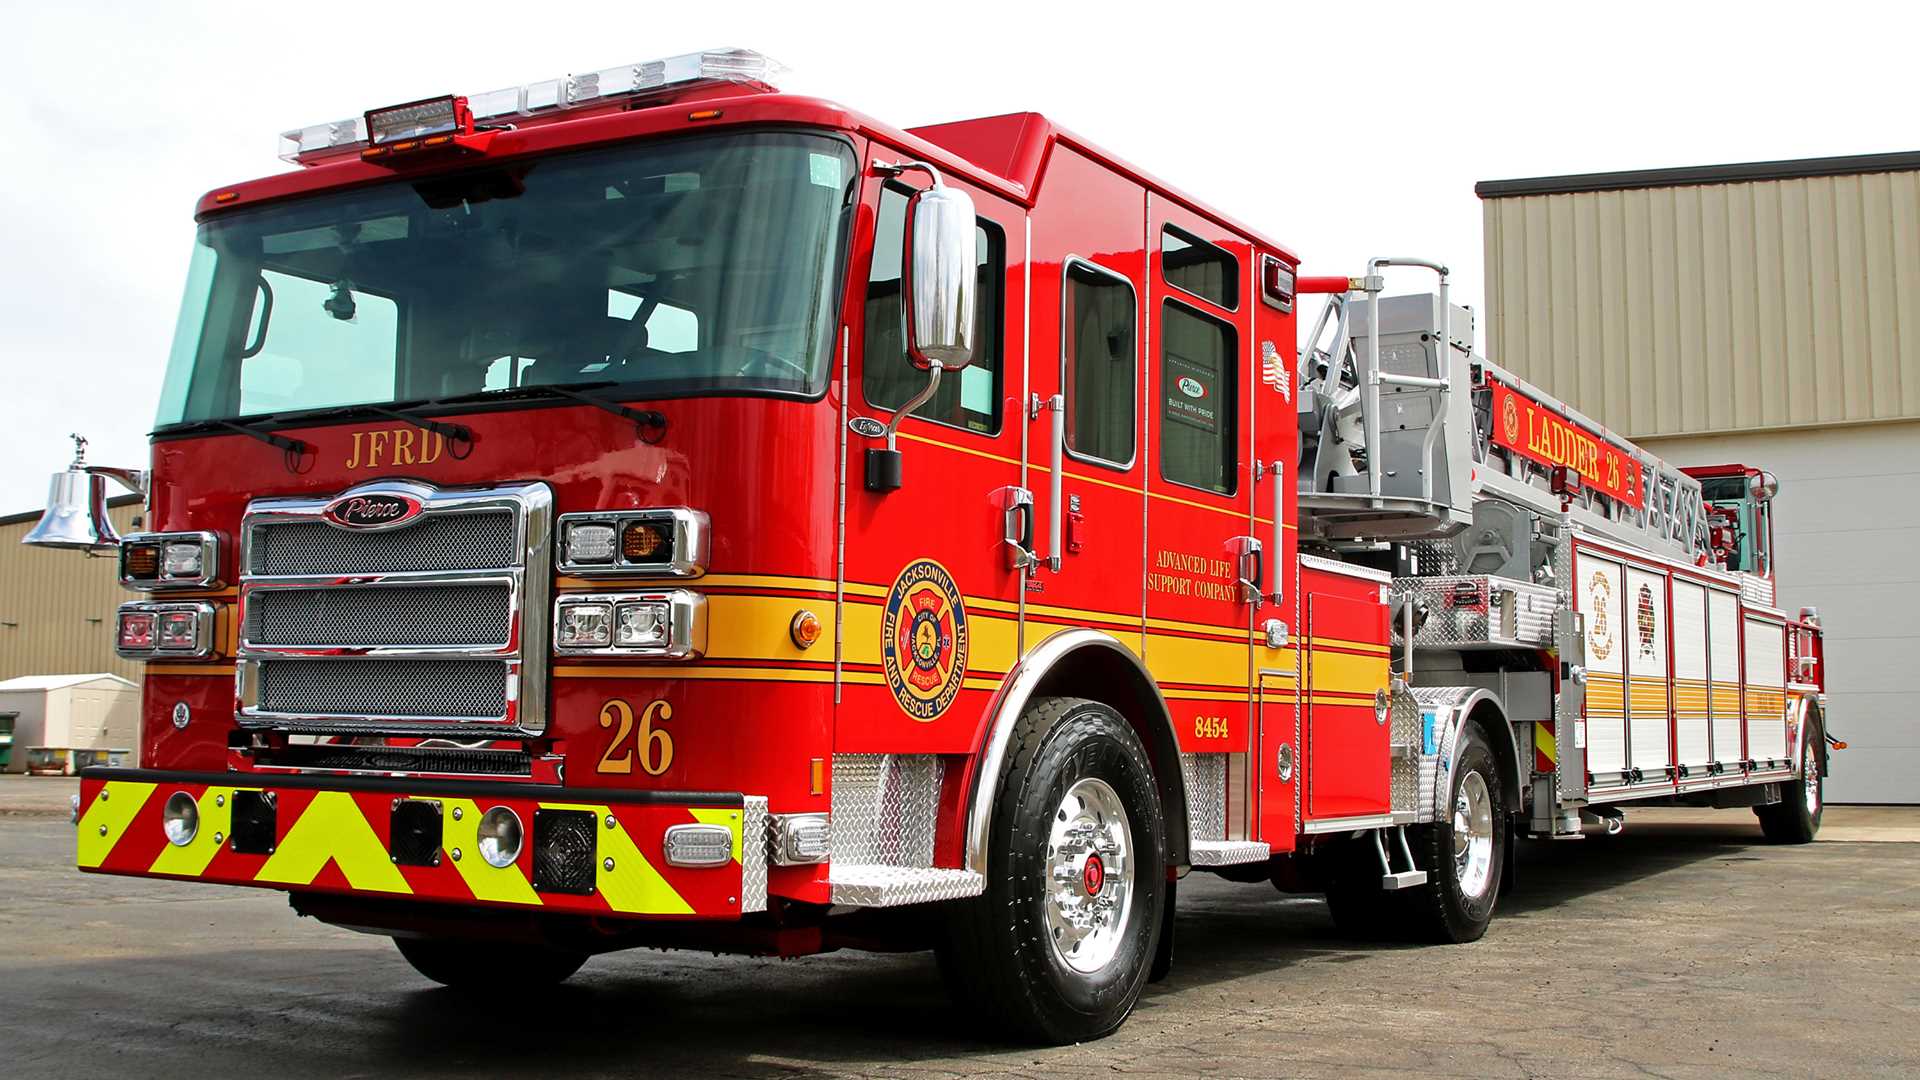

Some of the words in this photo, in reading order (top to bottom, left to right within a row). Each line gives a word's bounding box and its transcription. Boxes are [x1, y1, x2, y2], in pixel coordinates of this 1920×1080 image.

[1168, 398, 1184, 409] BUILT
[1184, 403, 1197, 413] WITH
[1198, 407, 1214, 419] PRIDE
[345, 429, 442, 469] JFRD
[1526, 407, 1600, 482] LADDER
[1606, 451, 1620, 491] 26
[344, 498, 400, 522] Pierce
[1156, 550, 1207, 575] ADVANCED
[1210, 559, 1231, 579] LIFE
[897, 565, 959, 608] JACKSONVILLE
[1148, 573, 1192, 595] SUPPORT
[1194, 581, 1237, 602] COMPANY
[919, 598, 936, 609] FIRE
[885, 612, 895, 649] FIRE
[886, 655, 901, 689] AND
[912, 672, 939, 686] RESCUE
[935, 623, 965, 712] DEPARTMENT
[898, 689, 934, 717] RESCUE
[597, 699, 674, 776] 26
[1195, 716, 1229, 739] 8454
